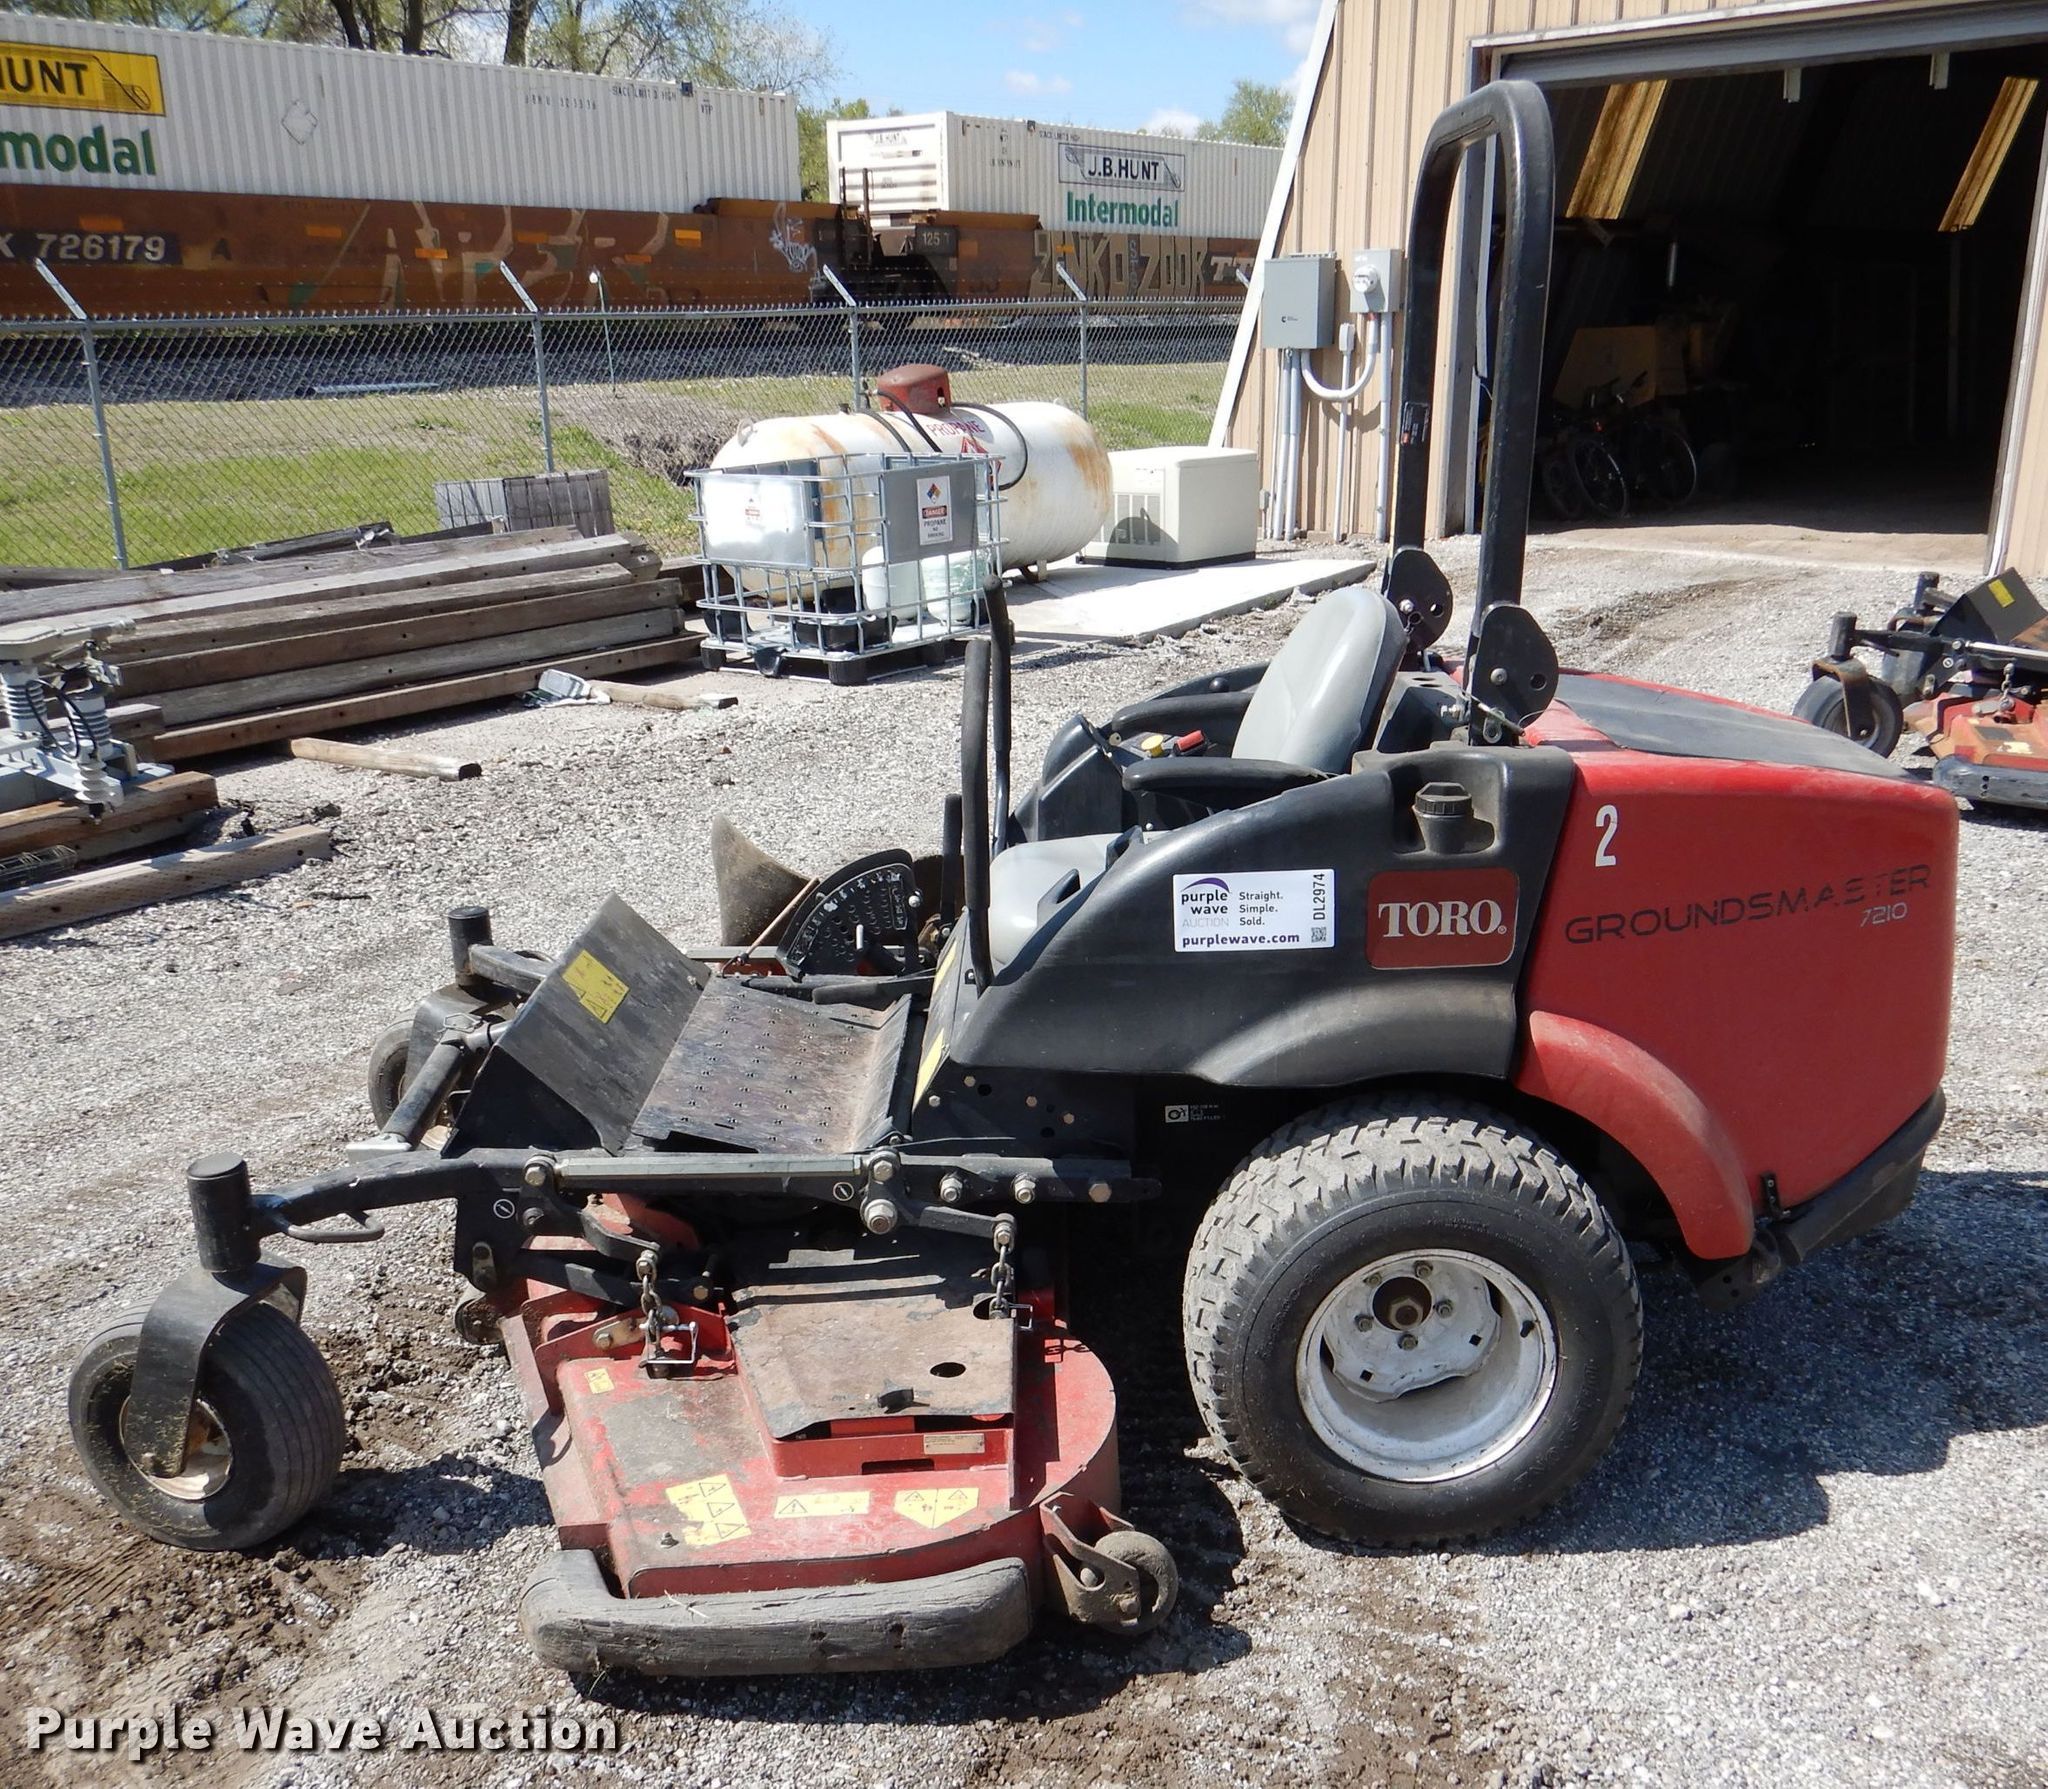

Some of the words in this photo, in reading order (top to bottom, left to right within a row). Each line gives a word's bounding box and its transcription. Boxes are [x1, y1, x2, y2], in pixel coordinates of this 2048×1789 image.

[0, 57, 88, 95] UNT
[1088, 155, 1159, 181] J.B.HUNT
[1066, 190, 1179, 227] Intermodal
[37, 233, 166, 262] 726179
[926, 420, 985, 437] PROPANE
[1595, 805, 1618, 867] 2
[1181, 890, 1228, 905] purple
[1239, 891, 1283, 902] Straight.
[1312, 873, 1326, 921] DL2974
[1191, 905, 1228, 915] wave
[1239, 904, 1278, 914] Simple.
[1378, 899, 1502, 938] TORO
[1860, 902, 1908, 927] 7210
[1182, 917, 1229, 928] AUCTION
[1239, 917, 1265, 926] Sold.
[1182, 933, 1300, 948] purplewave.com
